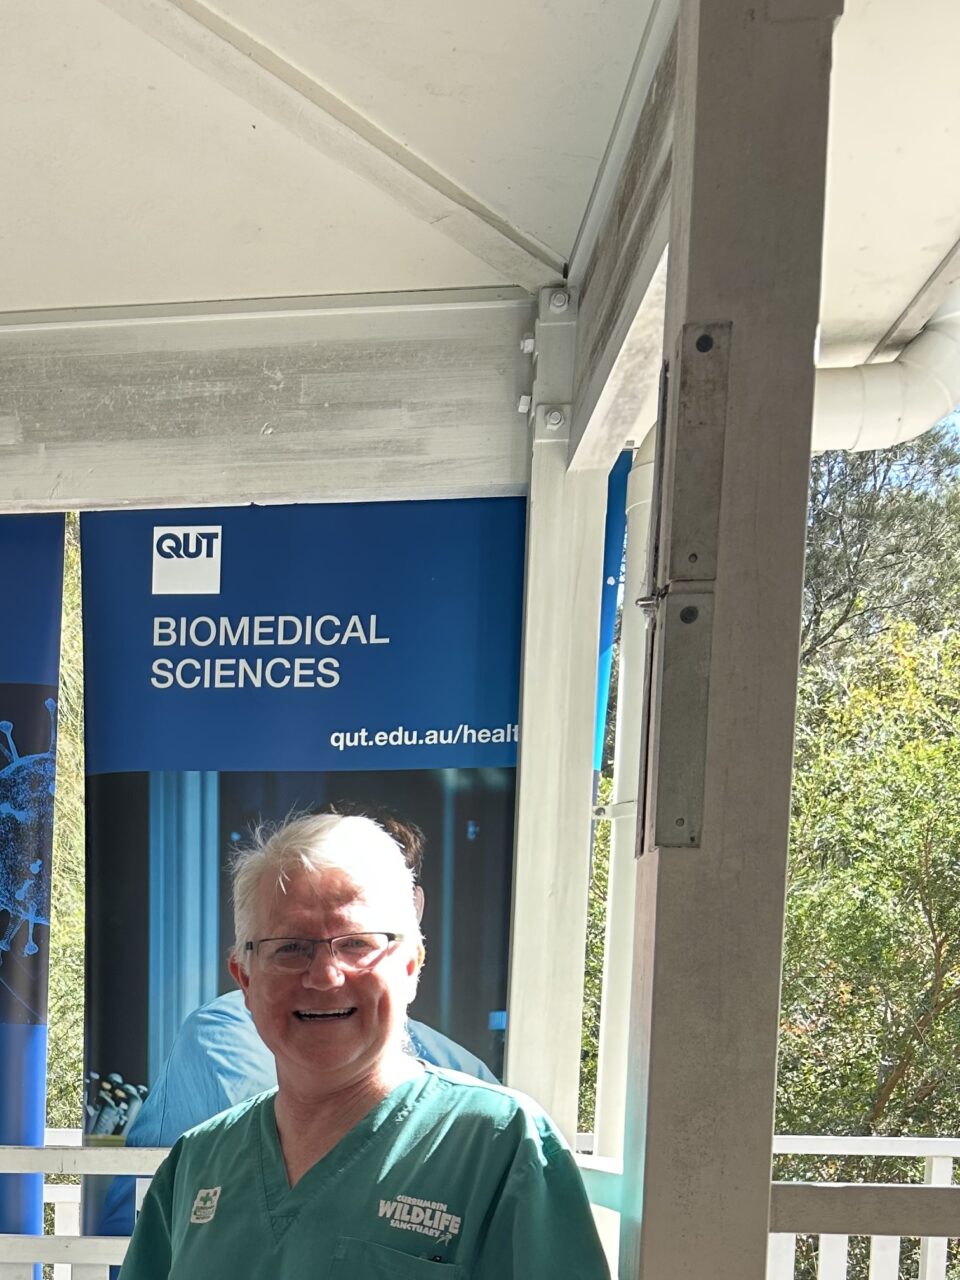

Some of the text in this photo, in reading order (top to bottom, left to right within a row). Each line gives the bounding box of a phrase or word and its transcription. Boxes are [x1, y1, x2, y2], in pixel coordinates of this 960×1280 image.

[156, 532, 219, 560] QUT
[152, 614, 390, 647] BIOMEDICAL
[150, 657, 340, 689] SCIENCES
[378, 1199, 461, 1235] WILDLIFE
[390, 1219, 441, 1238] SANCTUARY
